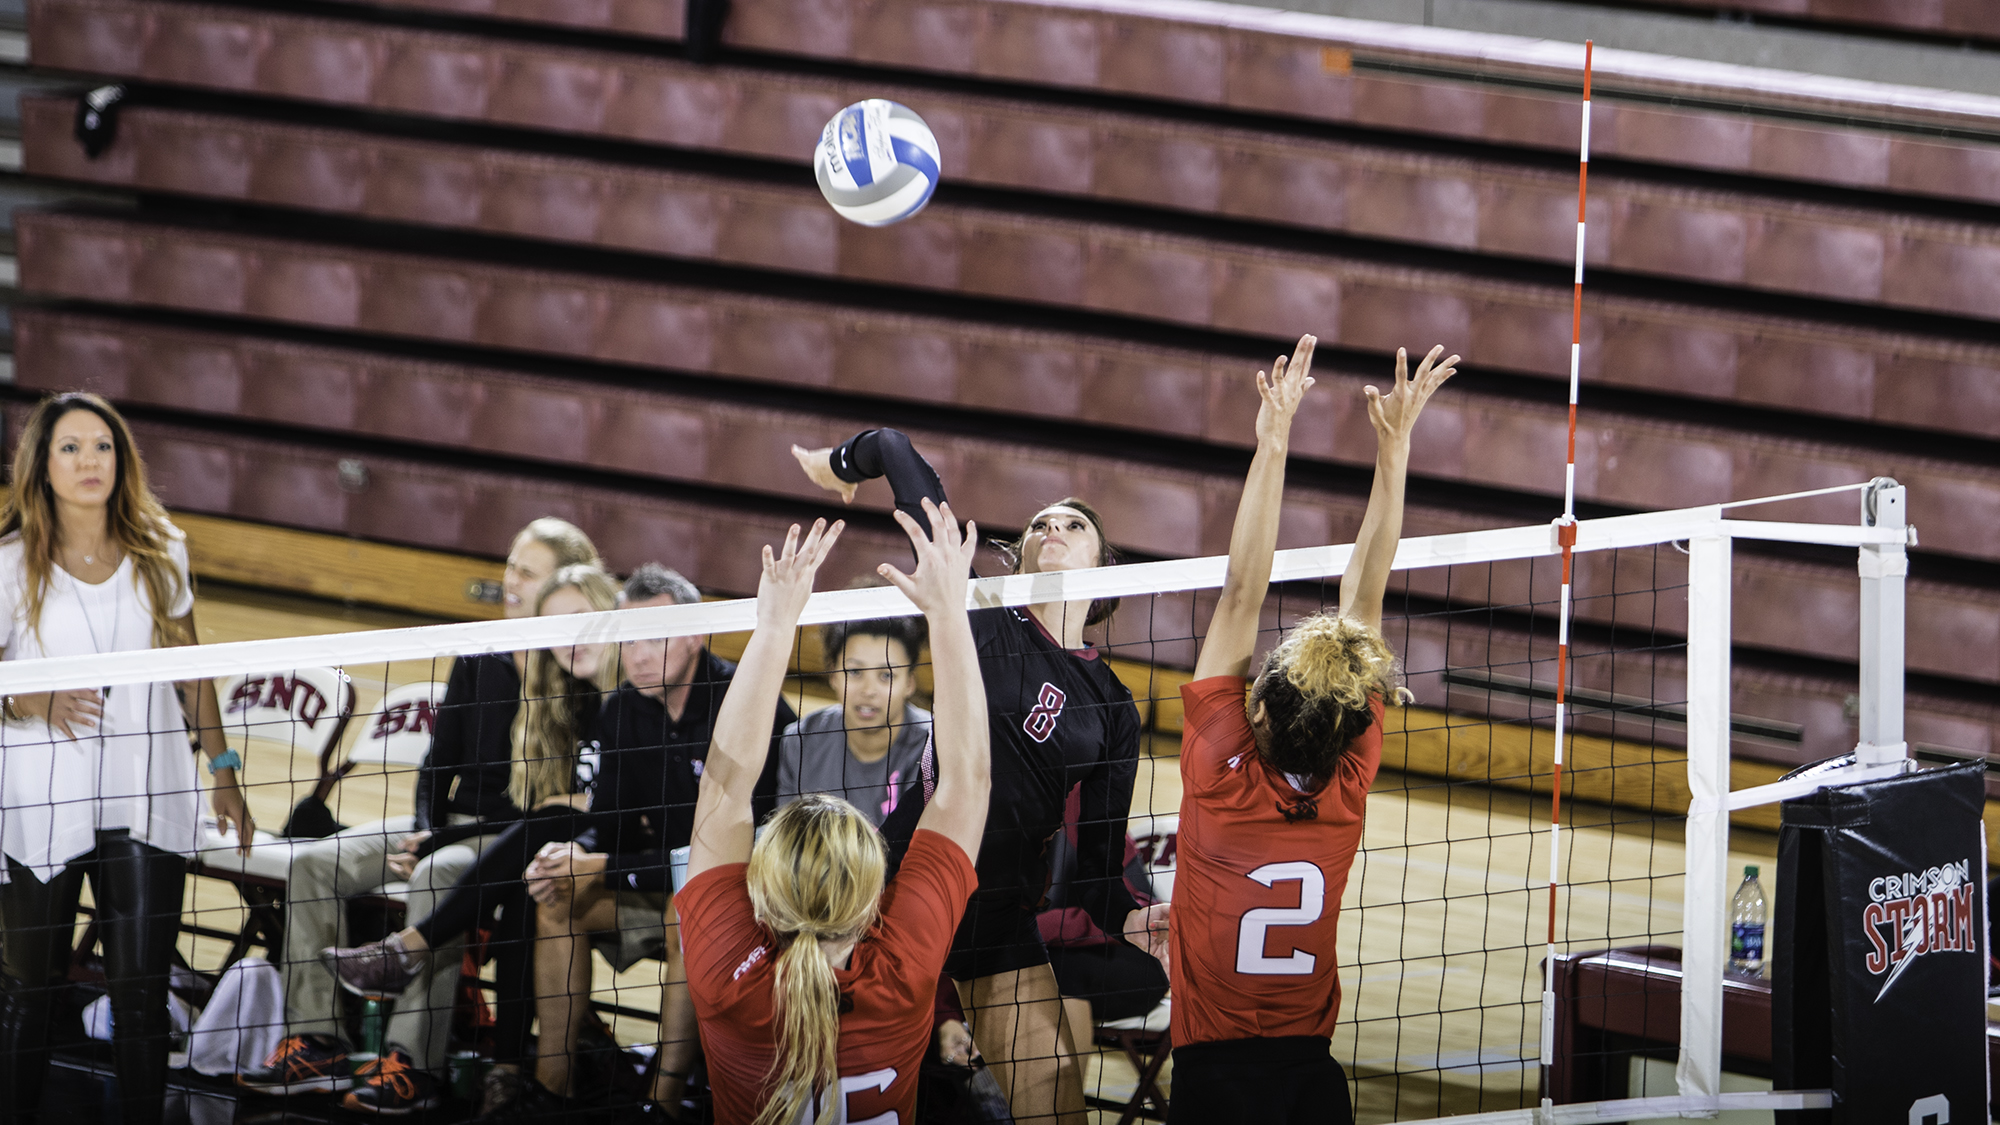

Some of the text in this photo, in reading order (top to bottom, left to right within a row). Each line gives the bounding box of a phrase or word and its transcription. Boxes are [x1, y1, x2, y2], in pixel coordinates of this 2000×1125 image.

[225, 674, 328, 729] SNU
[372, 701, 445, 740] SN
[1023, 682, 1067, 743] 8
[1868, 858, 1970, 902] CRIMSON
[1235, 860, 1325, 975] 2
[1863, 882, 1976, 975] STORM
